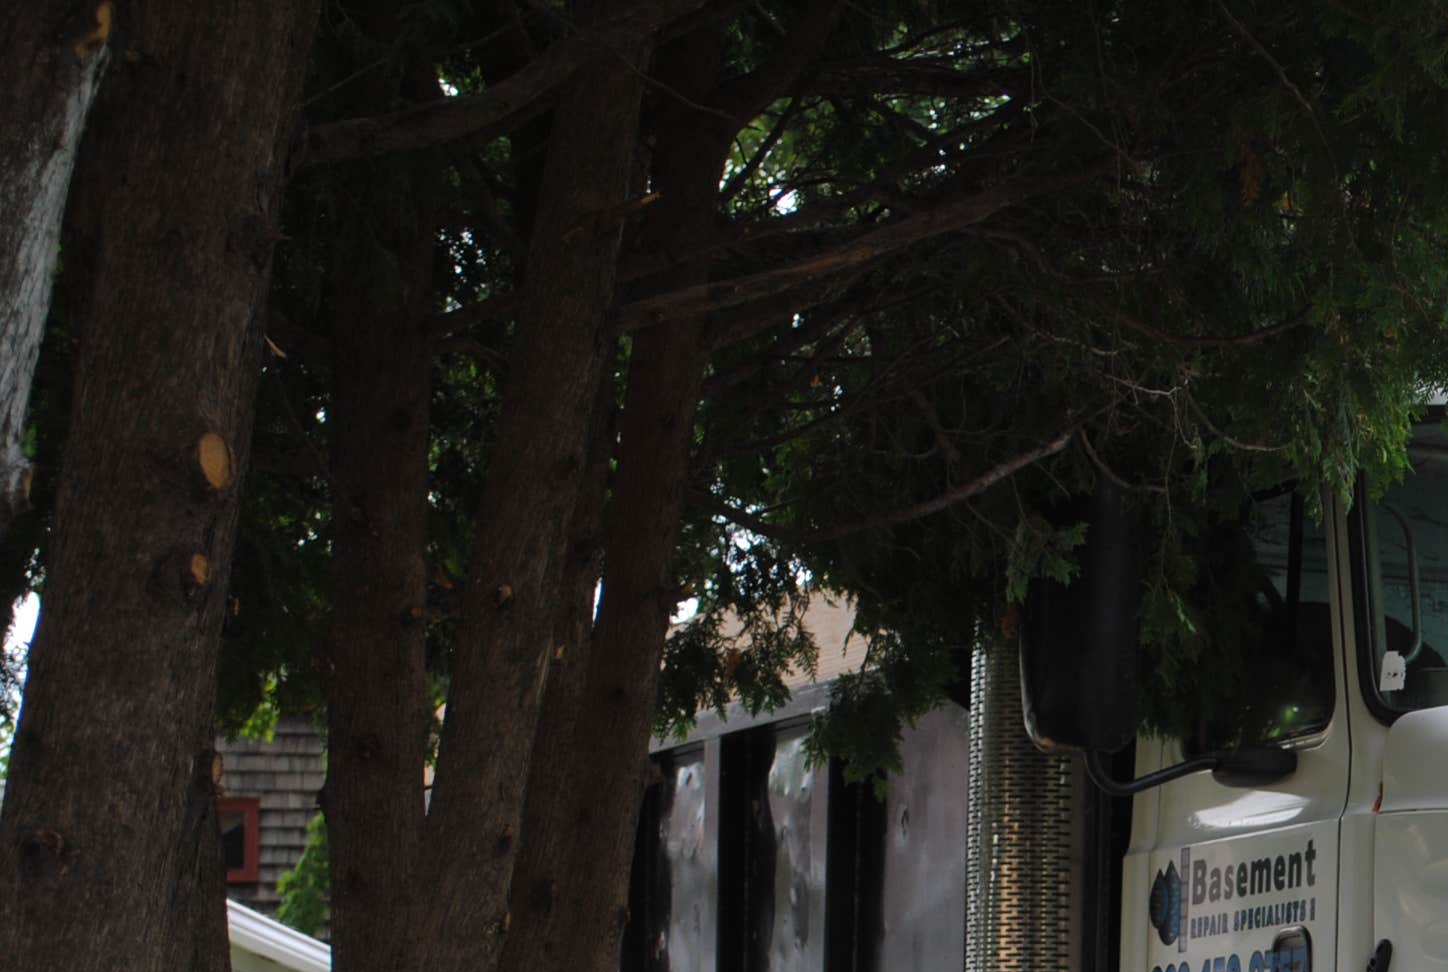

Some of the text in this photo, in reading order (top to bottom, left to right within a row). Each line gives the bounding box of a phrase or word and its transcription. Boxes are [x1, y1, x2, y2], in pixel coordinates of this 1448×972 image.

[1191, 839, 1316, 905] Basement
[1190, 913, 1229, 939] REPAIR
[1234, 899, 1307, 932] SPECIALISTS
